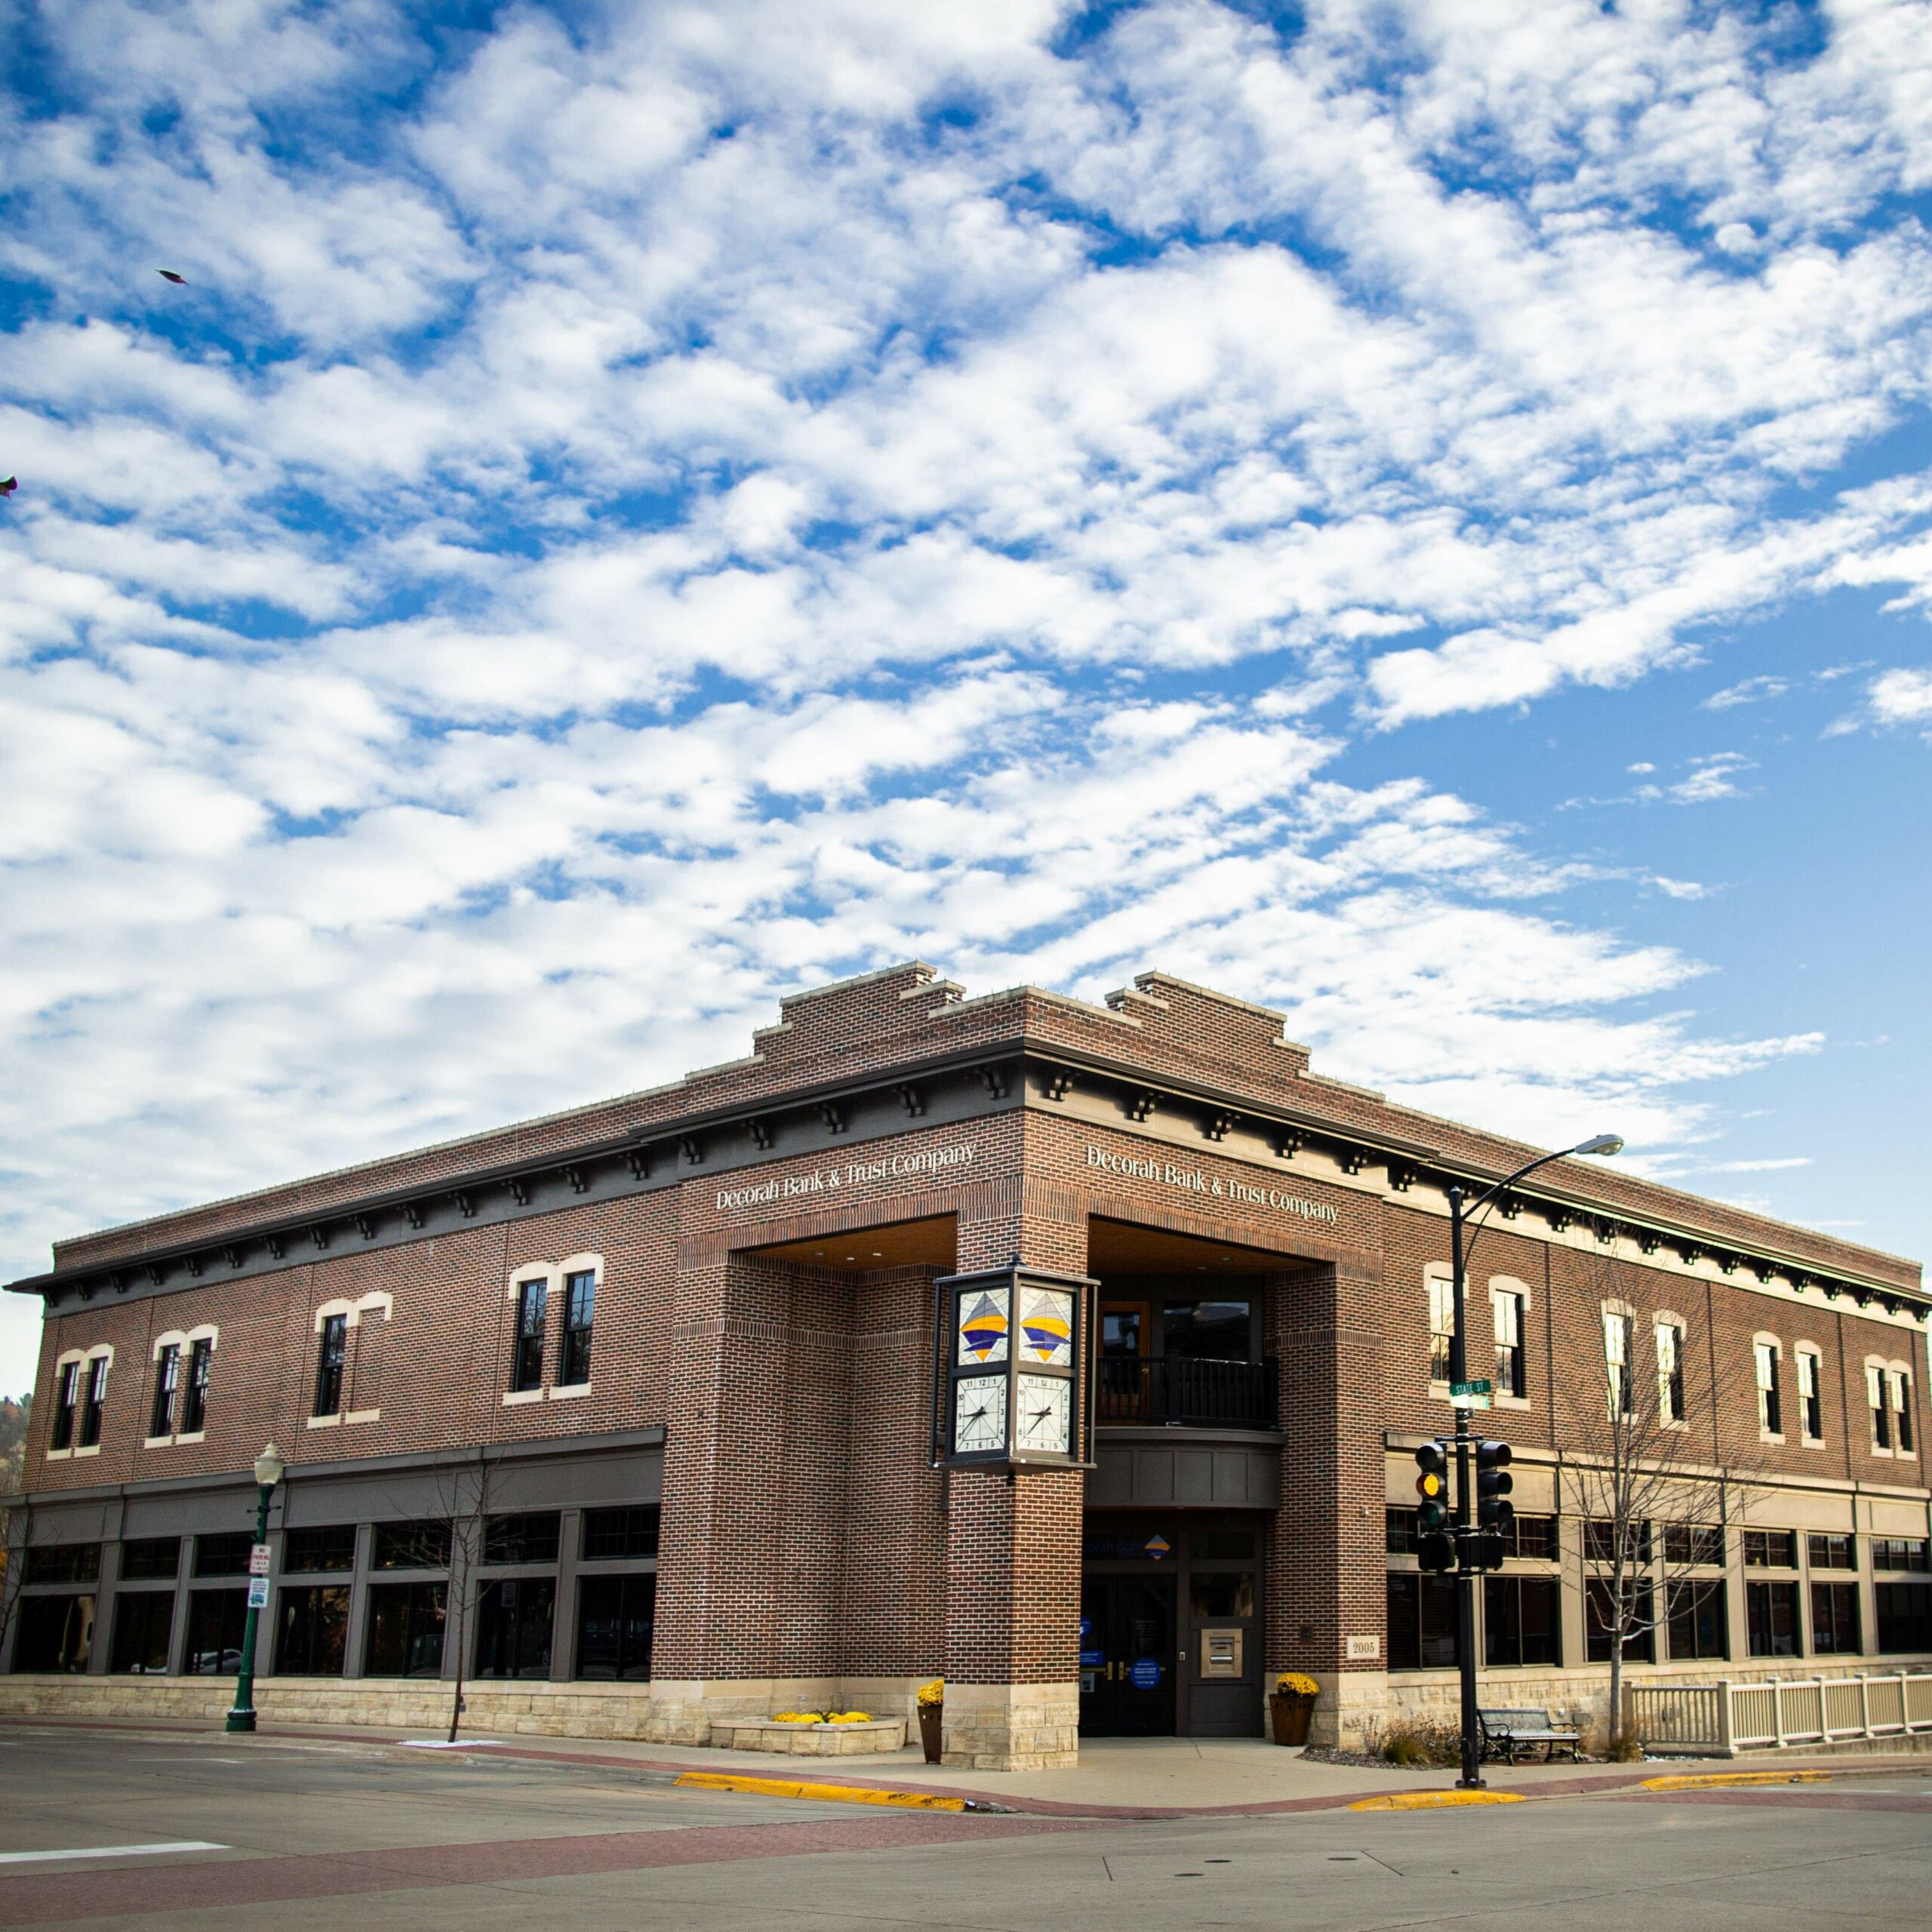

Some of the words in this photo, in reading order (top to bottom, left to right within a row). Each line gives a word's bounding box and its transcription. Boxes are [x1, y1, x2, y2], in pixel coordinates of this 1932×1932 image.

[716, 1180, 779, 1210] Decorah
[783, 1171, 824, 1198] Bank
[829, 1169, 841, 1188] &
[845, 1159, 888, 1184] Trust
[892, 1143, 977, 1175] Company
[1087, 1145, 1161, 1181] Decorah
[1164, 1163, 1207, 1192] Bank
[1211, 1177, 1222, 1196] &
[1226, 1179, 1266, 1204] Trust
[1269, 1189, 1340, 1226] Company
[1456, 1383, 1473, 1395] STATE
[1476, 1382, 1484, 1392] ST
[1353, 1642, 1375, 1654] 2005
